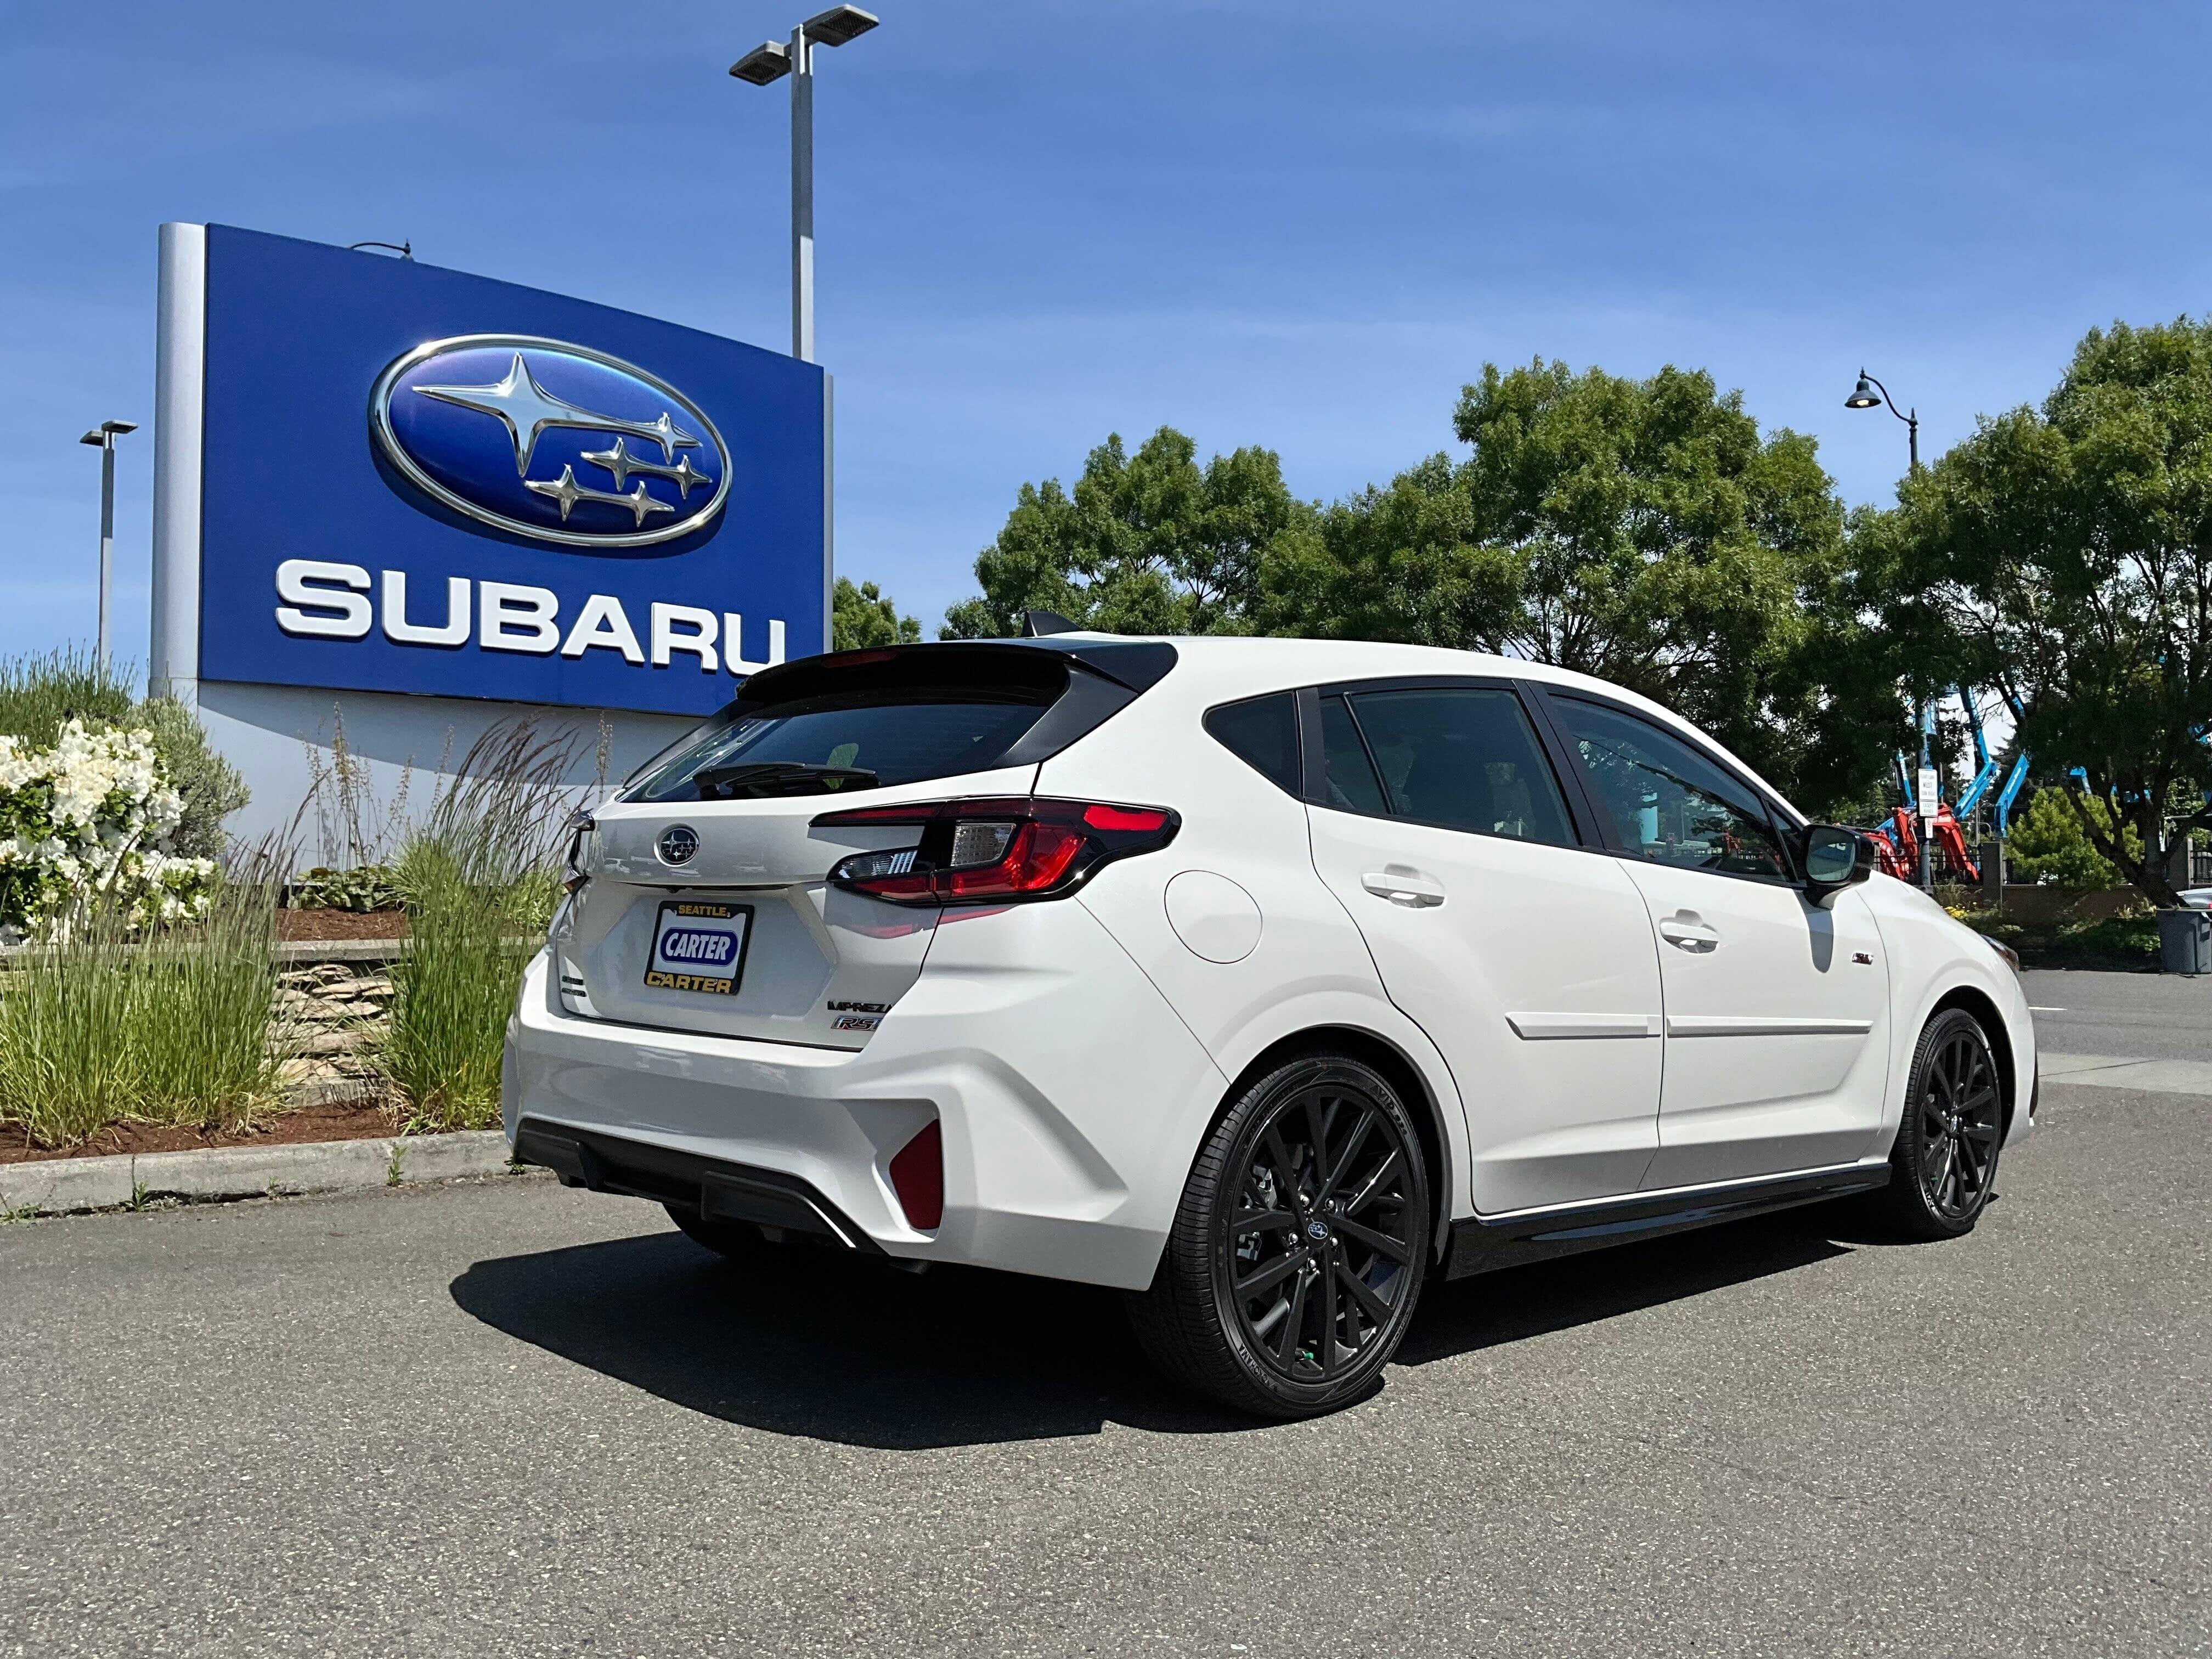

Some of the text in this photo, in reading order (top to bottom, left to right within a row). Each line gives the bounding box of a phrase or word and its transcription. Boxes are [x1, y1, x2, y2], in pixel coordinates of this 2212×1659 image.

[275, 558, 785, 675] SUBARU
[678, 905, 727, 917] SEATTLE
[665, 932, 731, 960] CARTER
[646, 971, 732, 994] CARTER
[836, 1016, 878, 1031] RS
